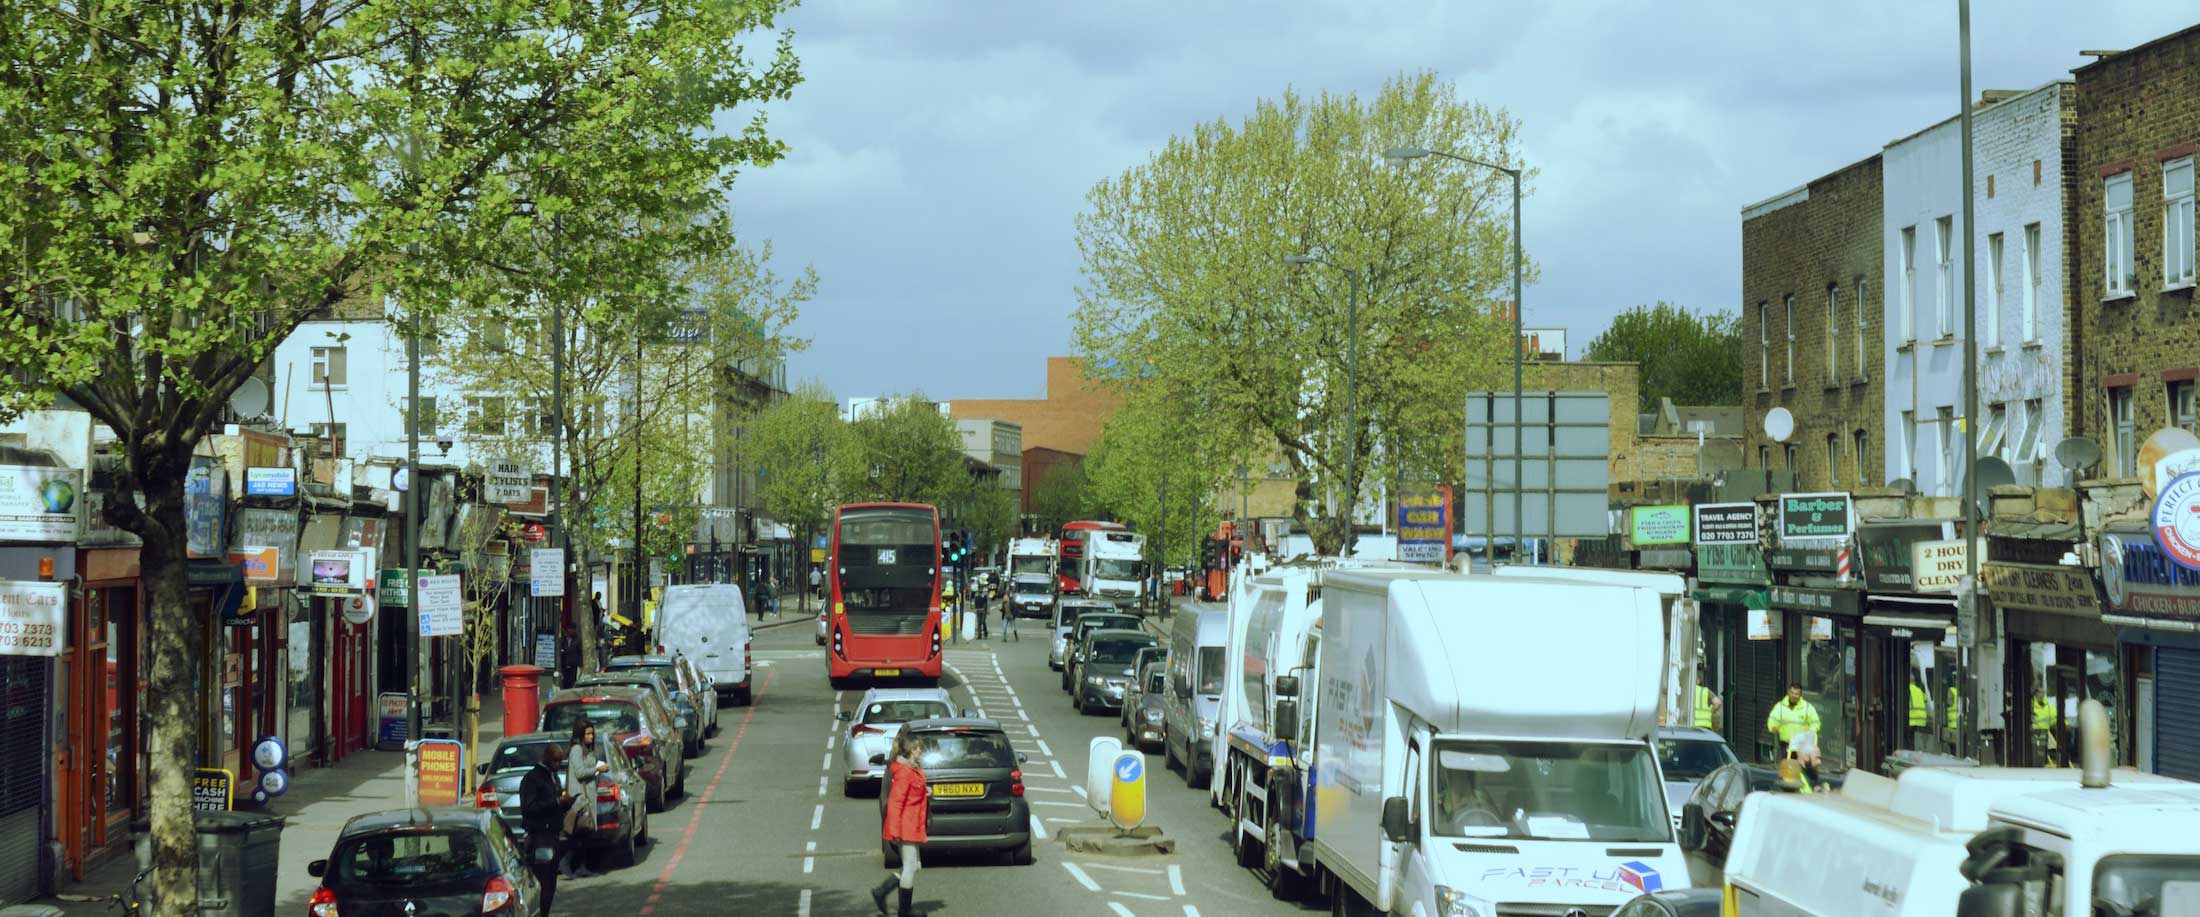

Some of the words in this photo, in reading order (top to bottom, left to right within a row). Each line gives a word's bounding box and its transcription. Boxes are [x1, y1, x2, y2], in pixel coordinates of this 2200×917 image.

[498, 464, 519, 473] HAIR
[489, 477, 528, 486] TYLISTS
[1787, 499, 1845, 512] Barber
[1407, 511, 1439, 524] CAR
[1401, 528, 1445, 539] WASH
[1787, 523, 1844, 534] Perfumes
[1701, 532, 1715, 540] 020
[879, 550, 896, 564] 415
[1924, 549, 1932, 558] 2
[1937, 546, 1967, 557] HOU
[1937, 560, 1964, 571] DRY
[1919, 574, 1984, 587] CLEANG
[382, 589, 408, 597] WITHO
[2132, 594, 2172, 615] CHICKEN
[24, 623, 53, 636] 7373
[23, 636, 52, 648] 6213
[422, 750, 455, 760] MOBILE
[421, 761, 456, 772] PHONES
[194, 778, 226, 788] FREE
[194, 787, 226, 797] CASH
[194, 803, 225, 811] HERE
[1482, 866, 1580, 881] FAST
[1528, 878, 1635, 894] PARCEL
